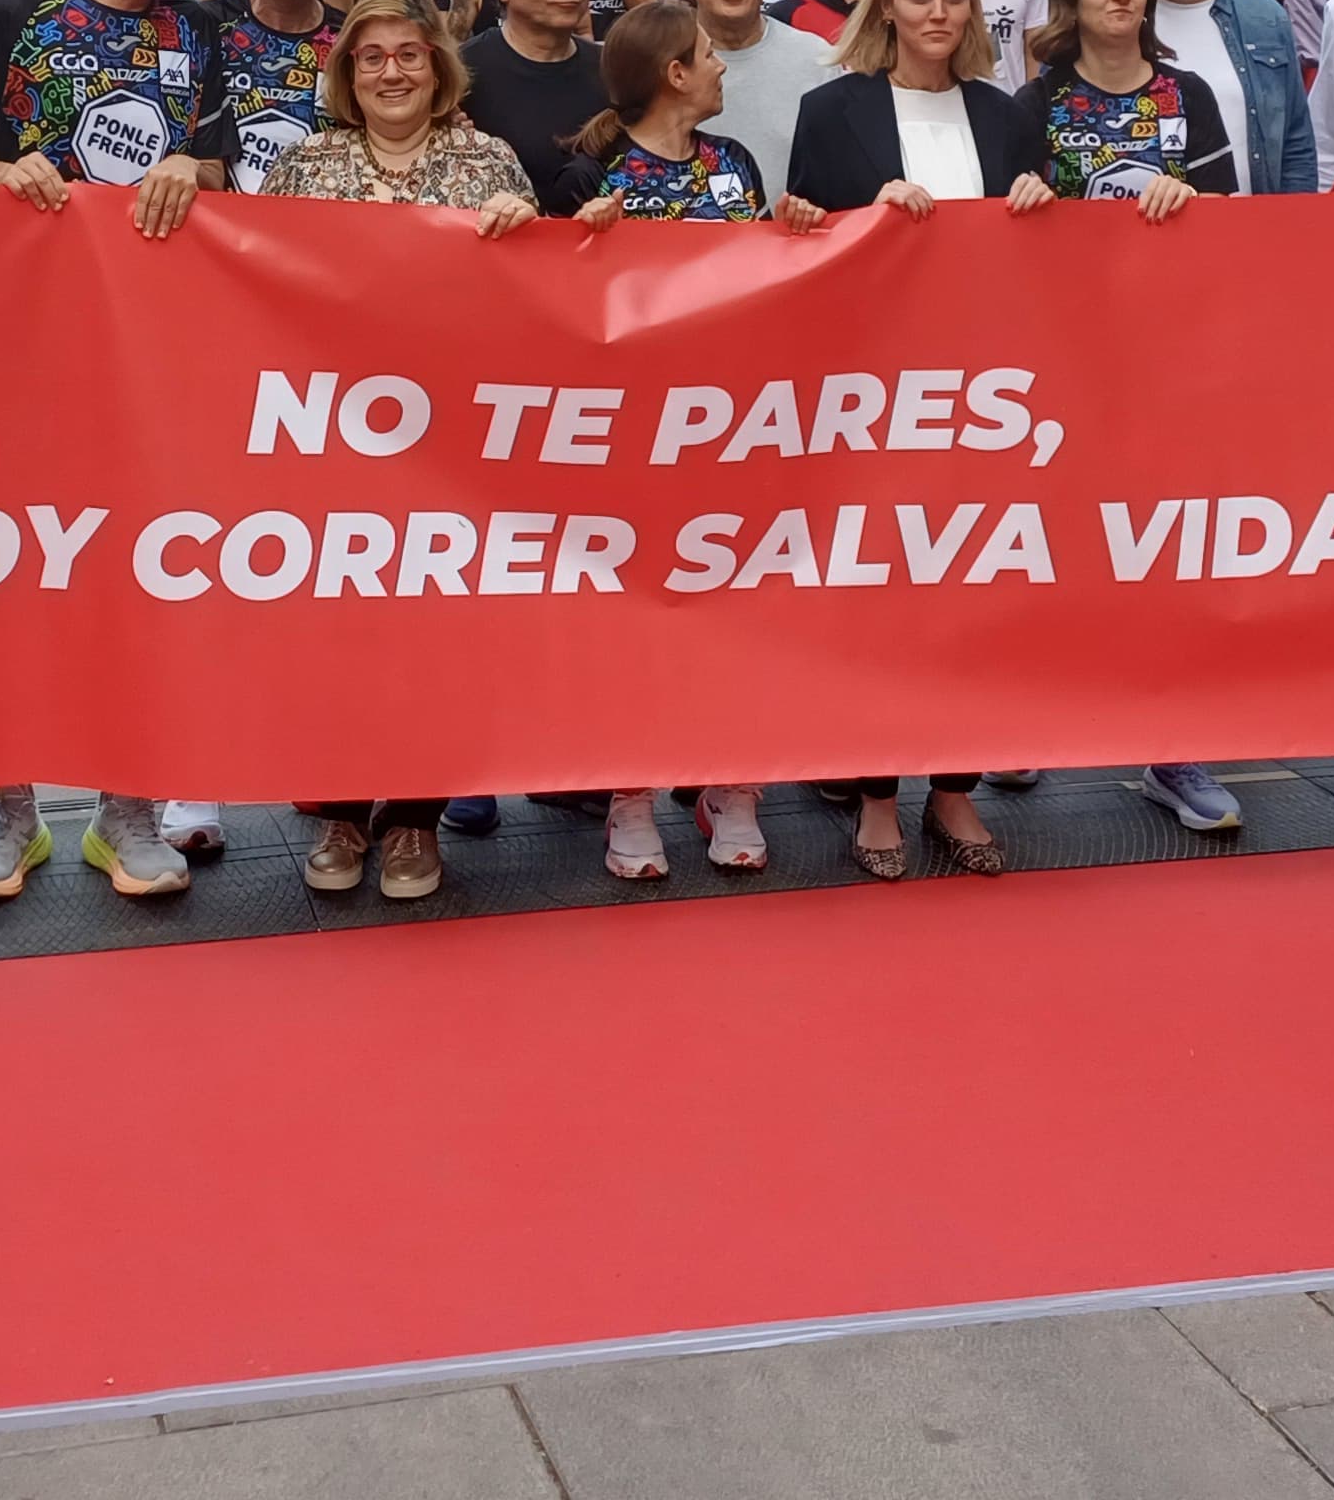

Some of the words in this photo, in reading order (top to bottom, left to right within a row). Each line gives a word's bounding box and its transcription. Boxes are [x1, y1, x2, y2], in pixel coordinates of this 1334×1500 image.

[87, 131, 153, 168] FRENO
[93, 113, 161, 151] PONLE
[242, 130, 285, 156] PON
[237, 151, 273, 175] FRE
[1100, 182, 1142, 201] PON
[246, 369, 431, 457] NO
[472, 382, 625, 466] TE
[648, 367, 1065, 467] PARES,
[131, 509, 637, 602] CORRER
[663, 502, 1057, 593] SALVA
